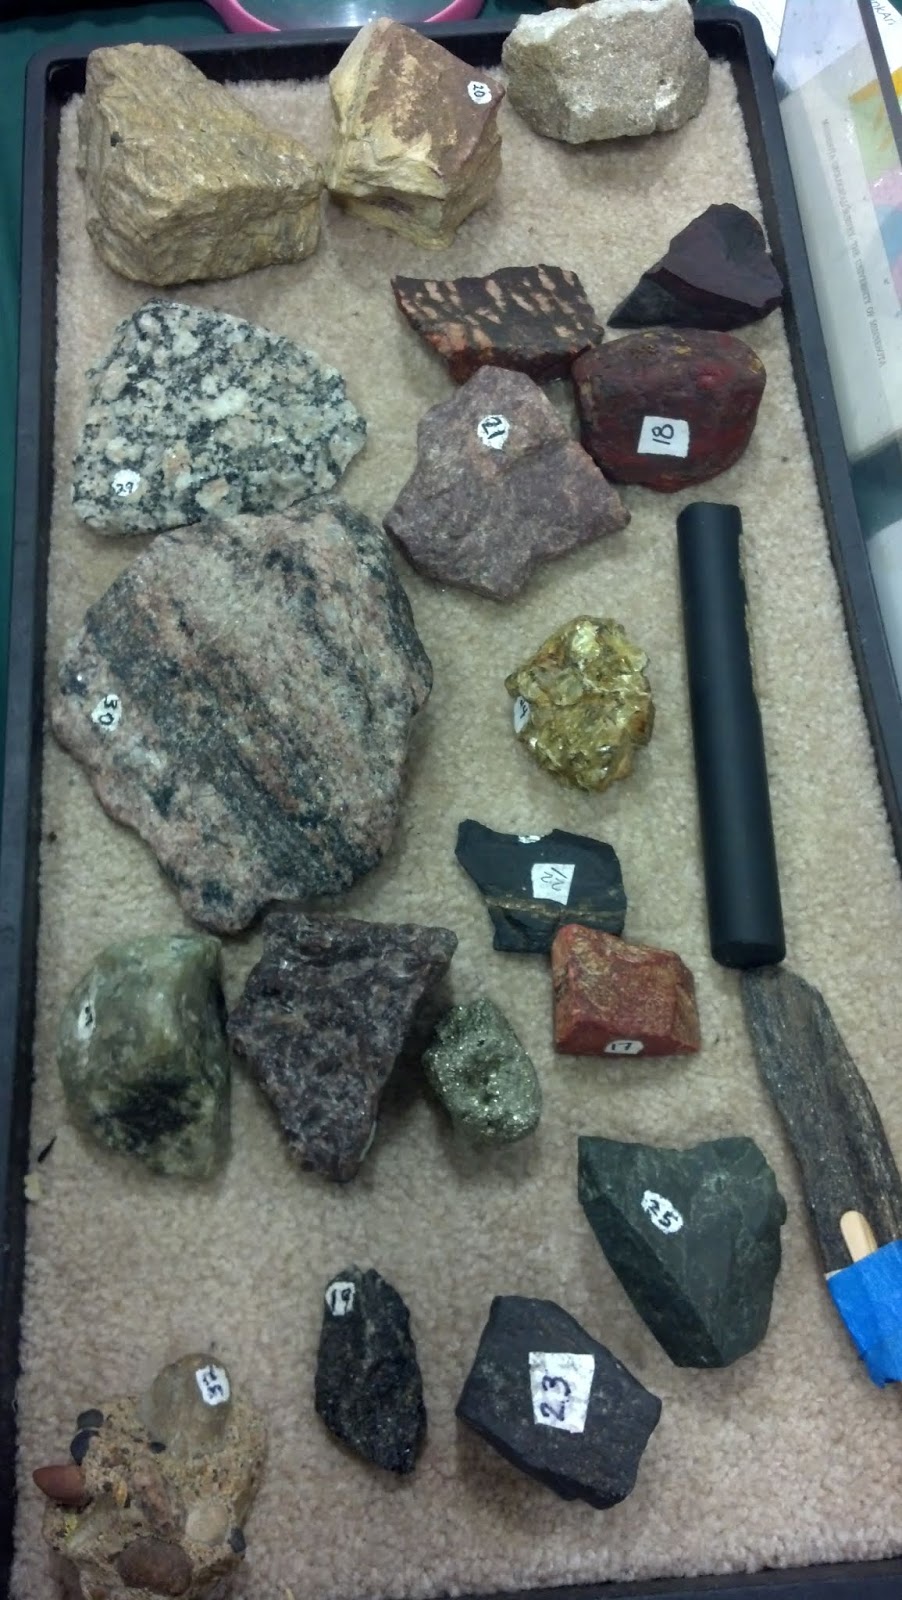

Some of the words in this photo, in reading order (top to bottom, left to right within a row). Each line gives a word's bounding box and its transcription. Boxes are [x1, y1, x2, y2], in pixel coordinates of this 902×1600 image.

[473, 84, 486, 98] 20
[652, 423, 674, 446] 18
[115, 481, 135, 496] 29
[98, 696, 118, 726] 30
[610, 1042, 633, 1051] 17
[648, 1199, 679, 1228] 25
[330, 1288, 351, 1313] 19
[540, 1375, 572, 1422] 23
